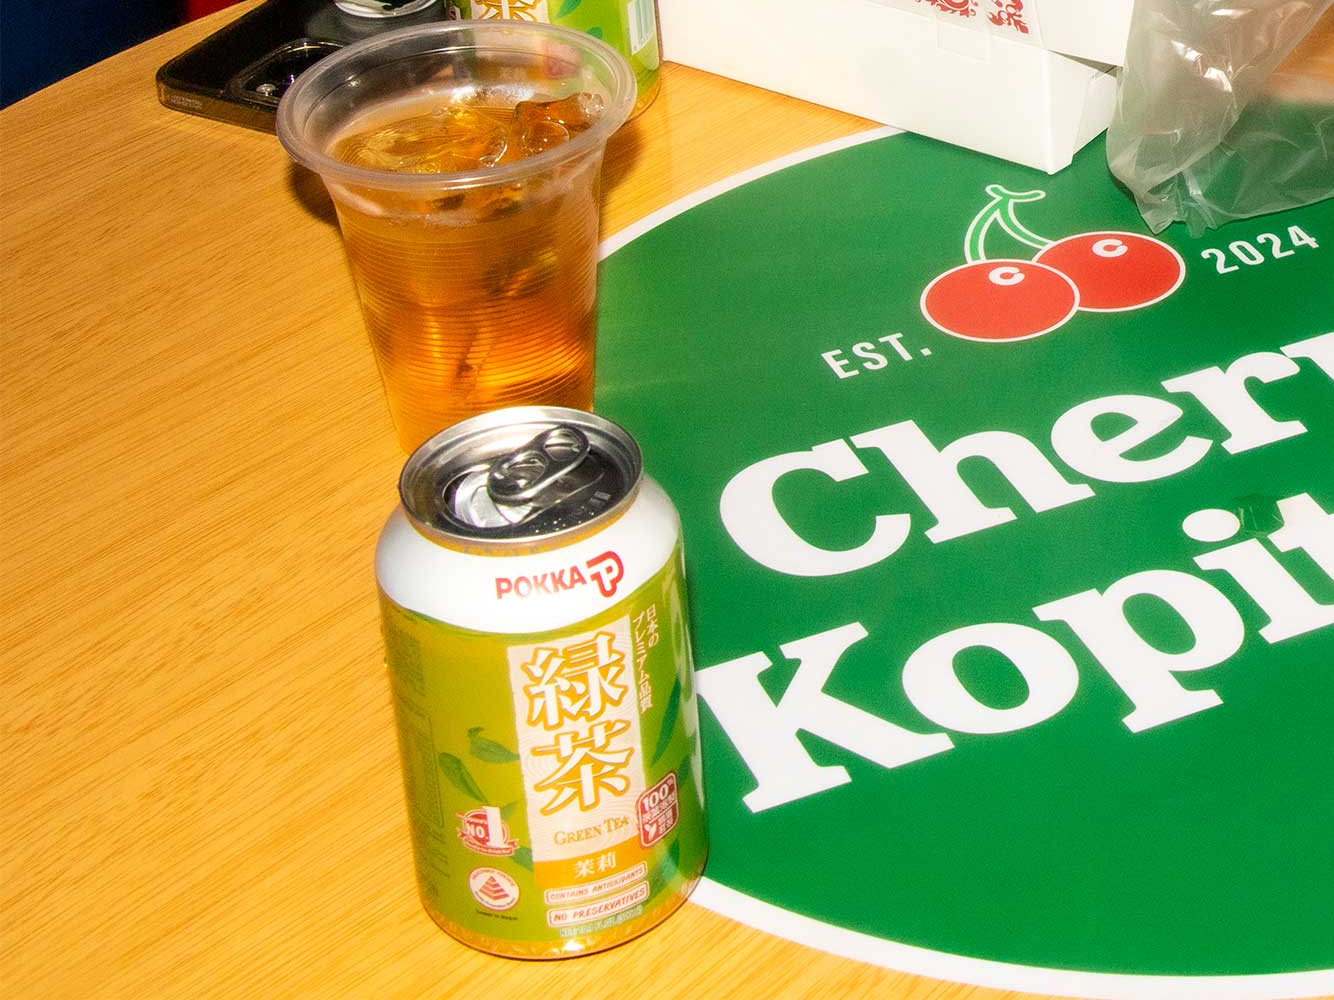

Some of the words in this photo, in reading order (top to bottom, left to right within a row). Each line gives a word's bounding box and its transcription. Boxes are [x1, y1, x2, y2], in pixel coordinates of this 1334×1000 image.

[821, 332, 932, 379] EST.
[1201, 224, 1319, 275] 2024
[495, 565, 587, 599] POKKA
[550, 887, 589, 900] CONTAINS
[553, 912, 568, 922] NO
[572, 887, 646, 919] PRESERVATIVES
